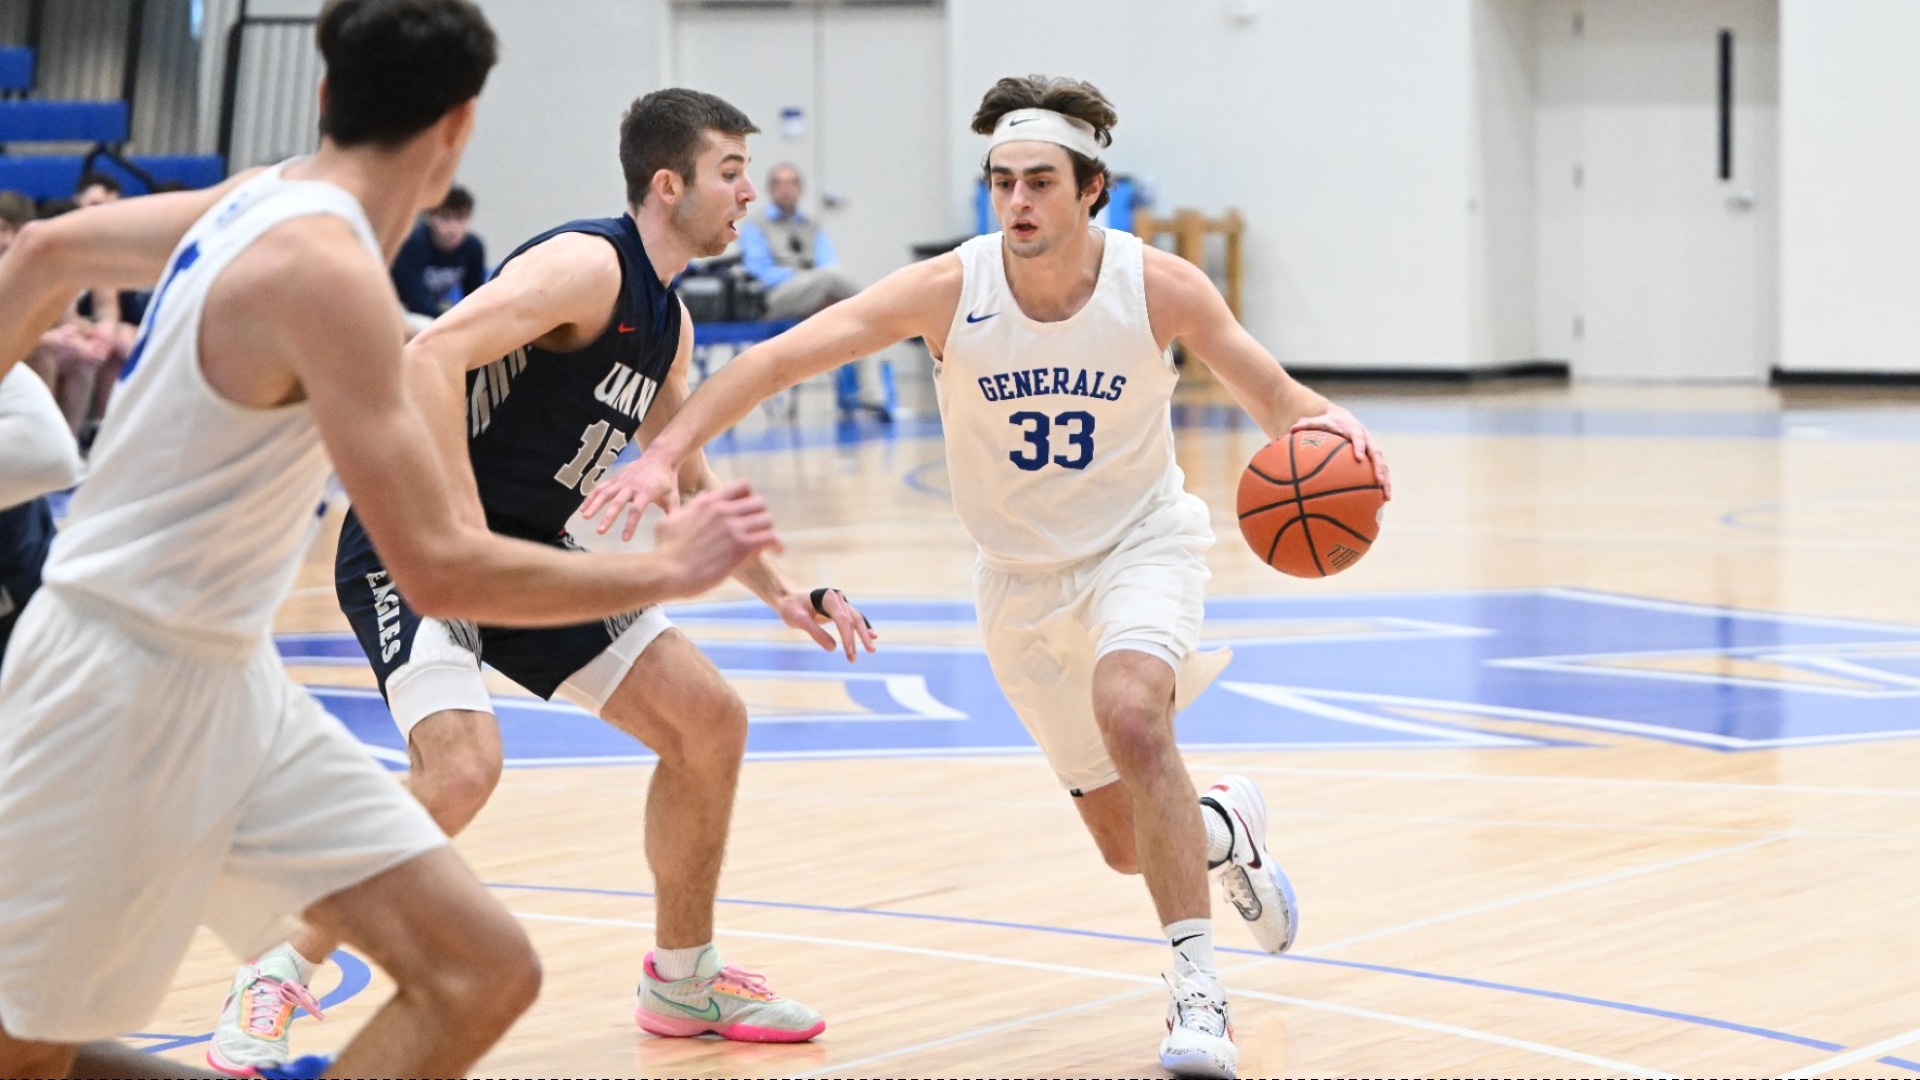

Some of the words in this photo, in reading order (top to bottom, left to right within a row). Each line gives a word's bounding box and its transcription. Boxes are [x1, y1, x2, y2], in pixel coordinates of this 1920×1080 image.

[977, 367, 1127, 401] GENERALS
[1009, 410, 1096, 471] 33
[365, 569, 401, 664] EAGLES
